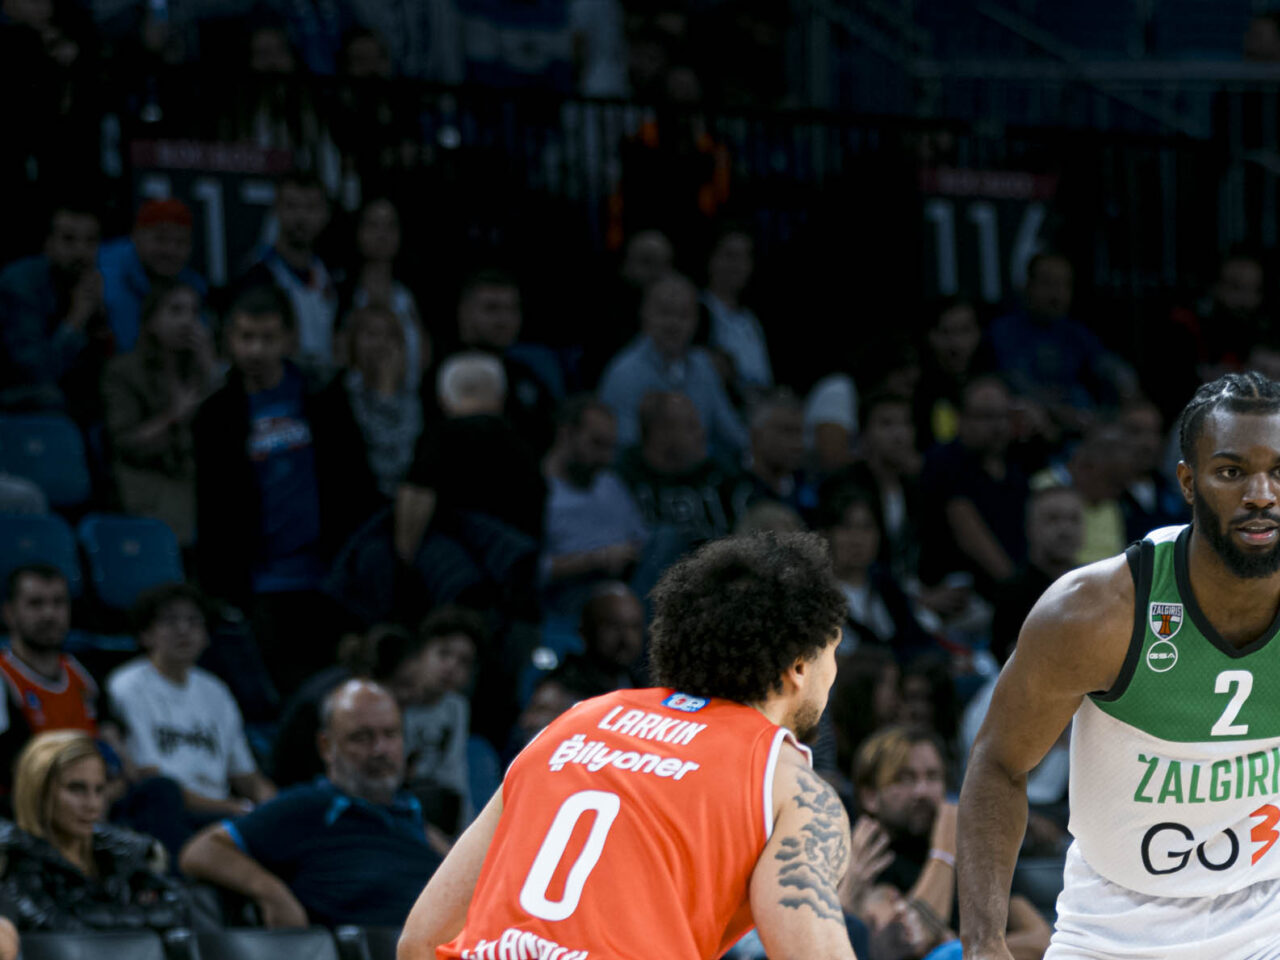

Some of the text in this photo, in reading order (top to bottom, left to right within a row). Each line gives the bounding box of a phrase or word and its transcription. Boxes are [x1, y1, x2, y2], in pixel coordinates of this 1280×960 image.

[597, 705, 708, 745] LARKIN
[1210, 670, 1254, 736] 2
[548, 733, 700, 780] Bilyoner
[519, 790, 621, 922] 0
